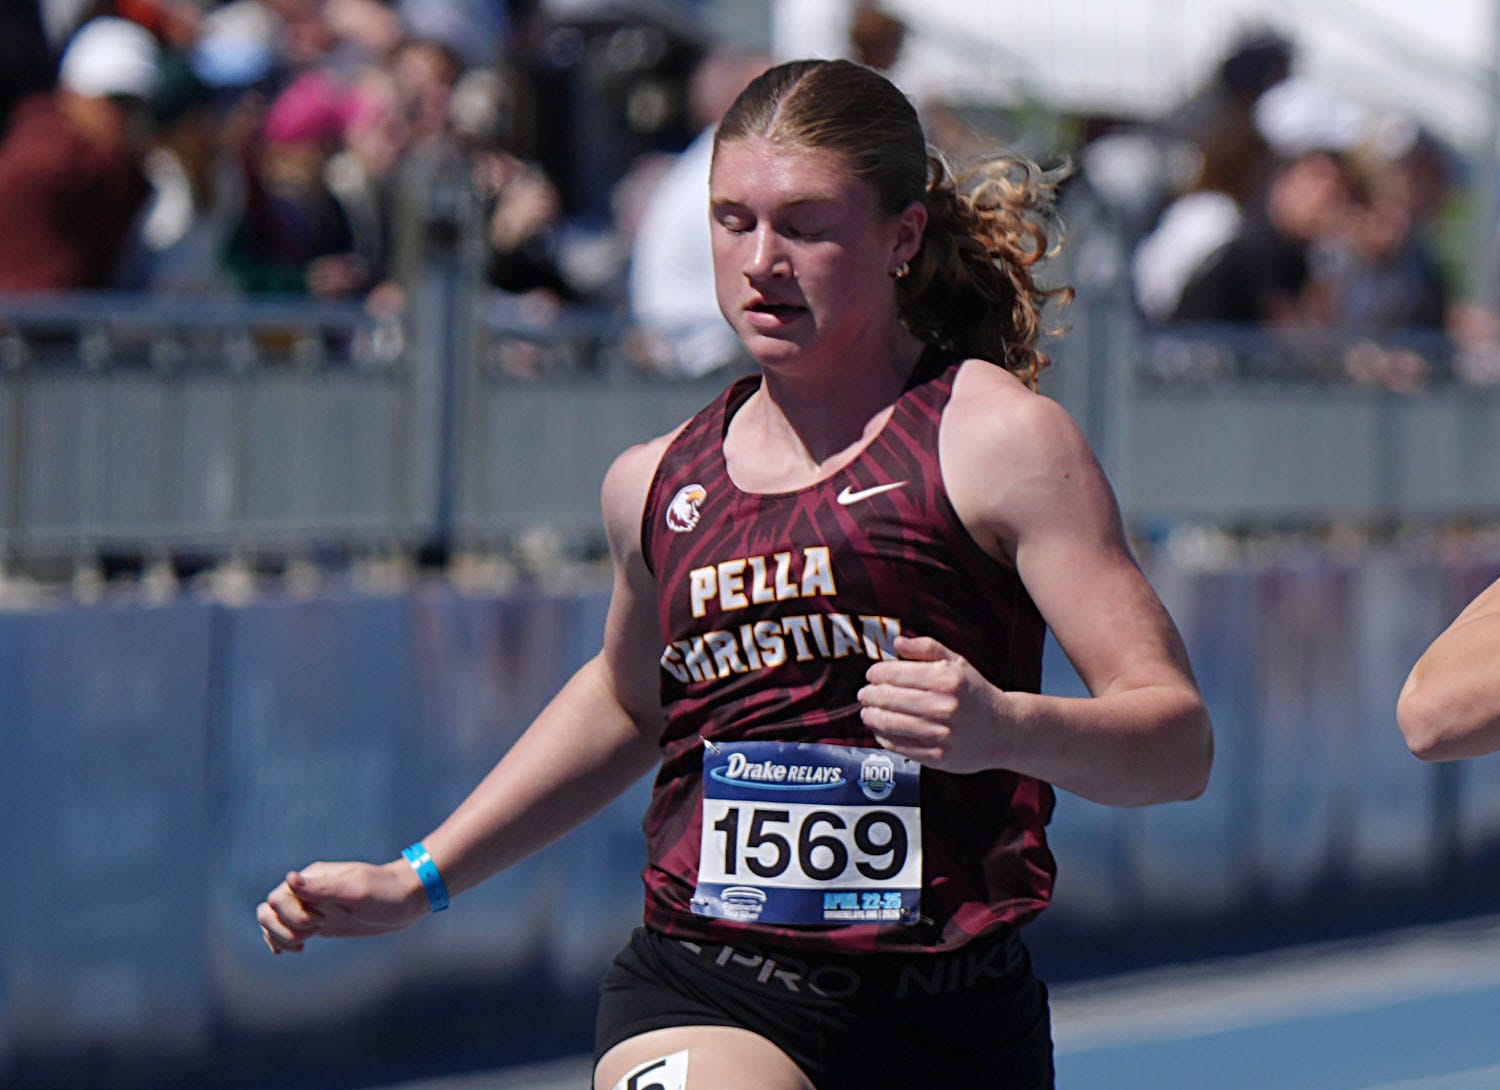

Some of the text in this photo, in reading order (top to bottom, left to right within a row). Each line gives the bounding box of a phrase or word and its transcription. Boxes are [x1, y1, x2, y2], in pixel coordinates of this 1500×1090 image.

[690, 546, 837, 618] PELLA
[660, 612, 902, 685] CHRISTIAN
[725, 752, 842, 783] Drake RELAYS
[864, 765, 890, 781] 100
[713, 806, 909, 881] 1569
[715, 943, 862, 997] PRO
